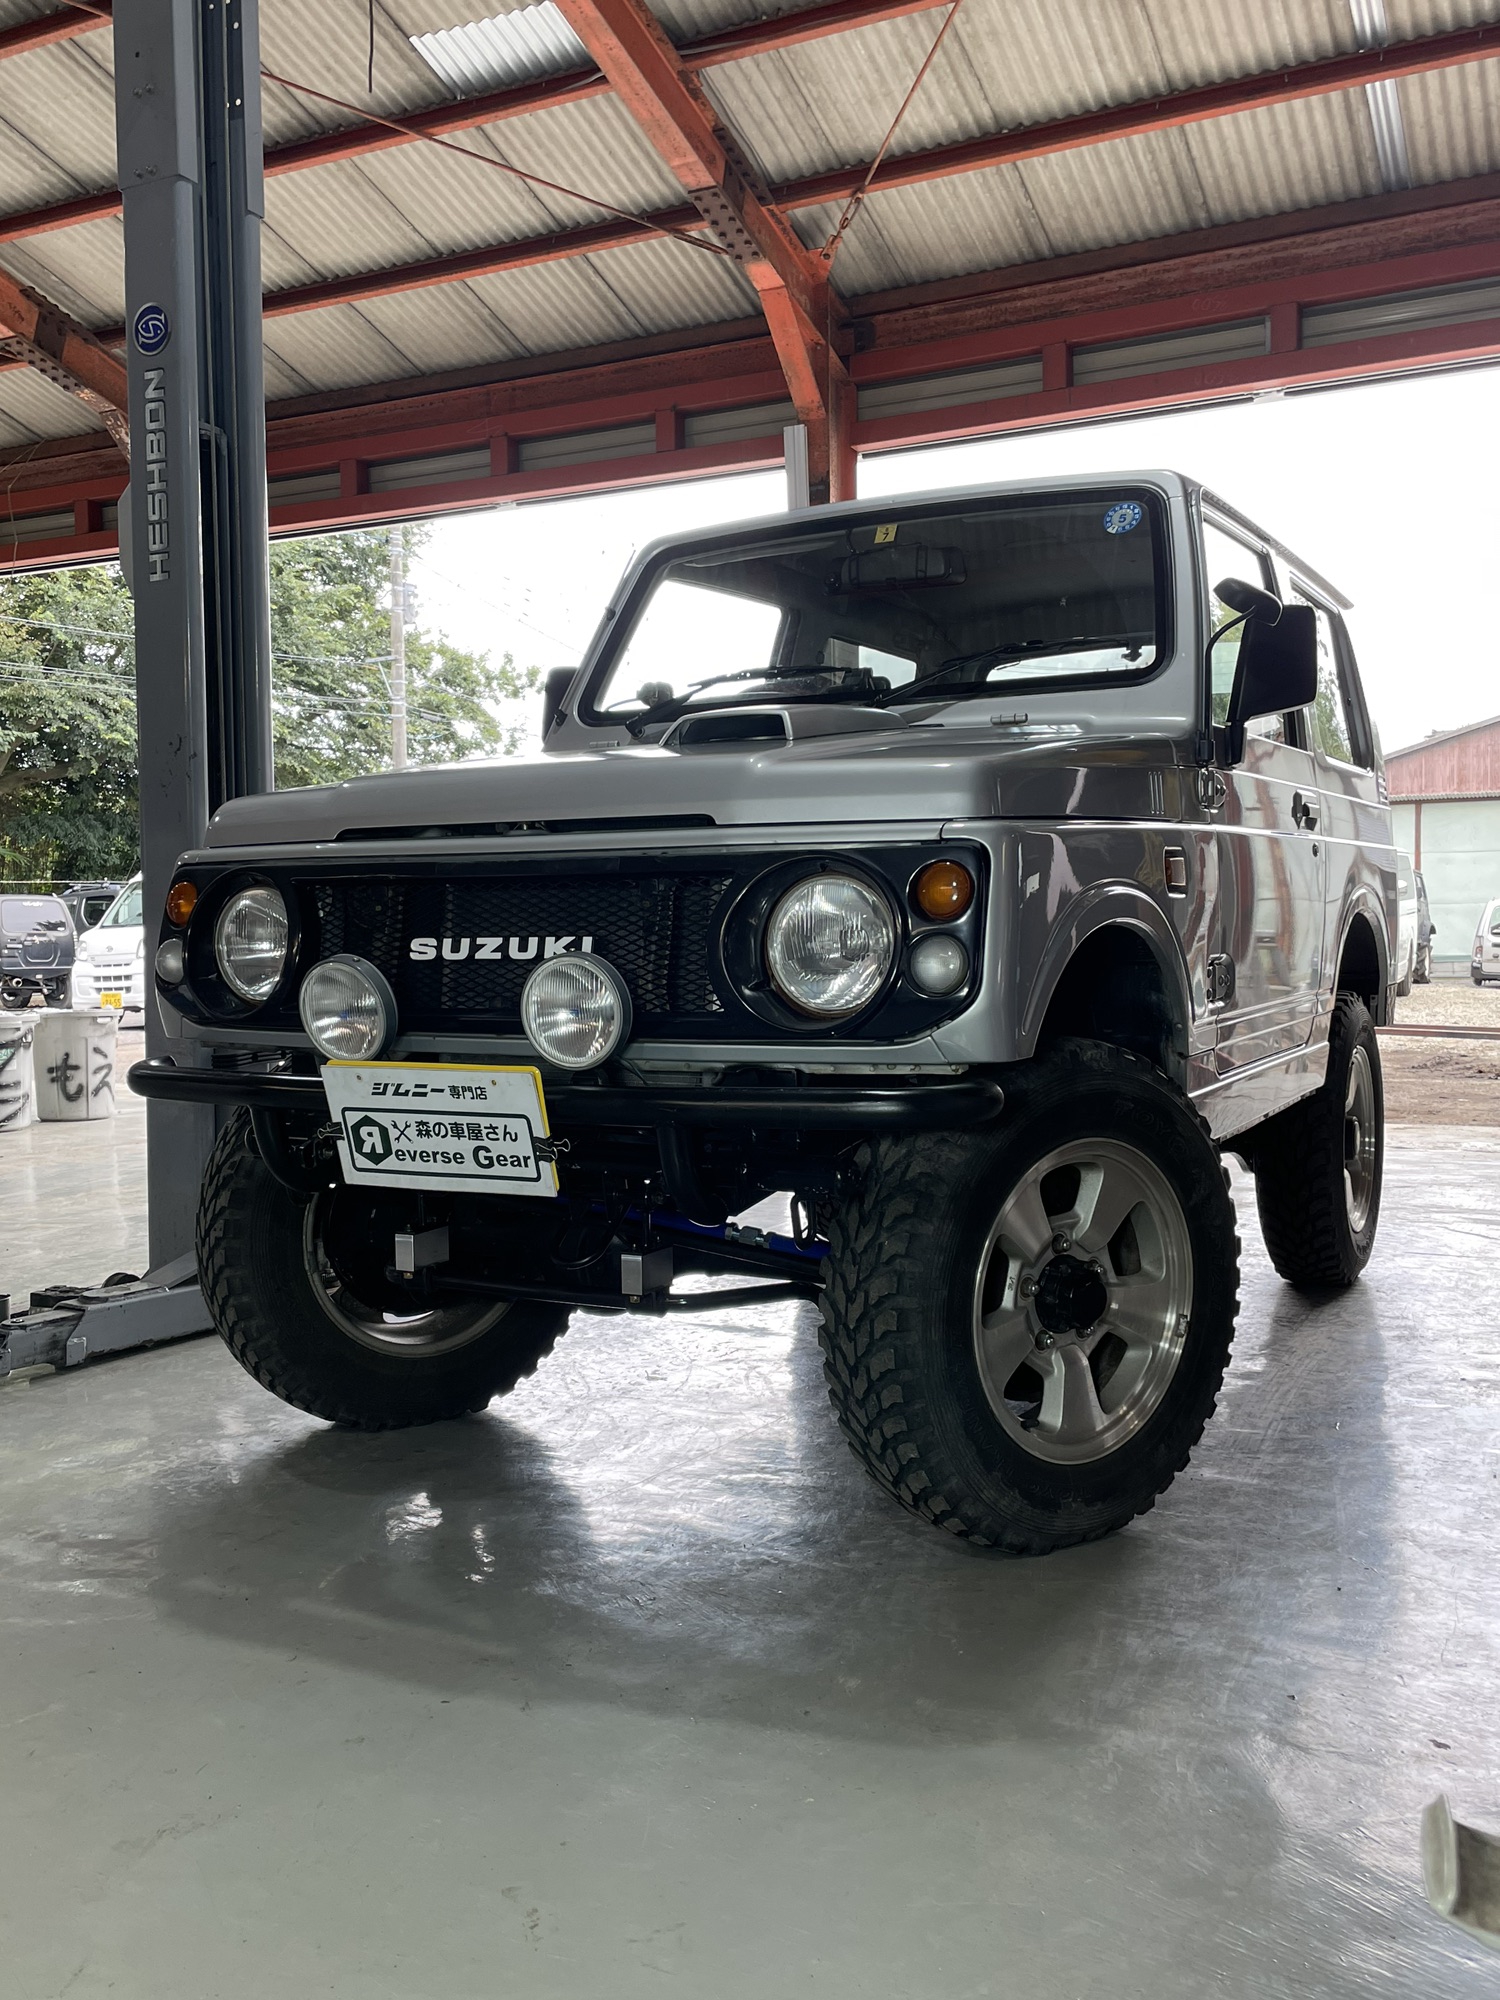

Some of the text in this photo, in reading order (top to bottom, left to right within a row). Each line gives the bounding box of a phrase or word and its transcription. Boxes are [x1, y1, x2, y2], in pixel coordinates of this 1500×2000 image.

[143, 367, 169, 582] HESHBON
[1118, 513, 1127, 523] 5
[882, 532, 889, 541] 7
[409, 936, 593, 960] SUZUKI
[371, 1082, 488, 1100] ジムニー専門店
[415, 1120, 518, 1143] 森の車屋さん
[472, 1145, 531, 1169] Gear
